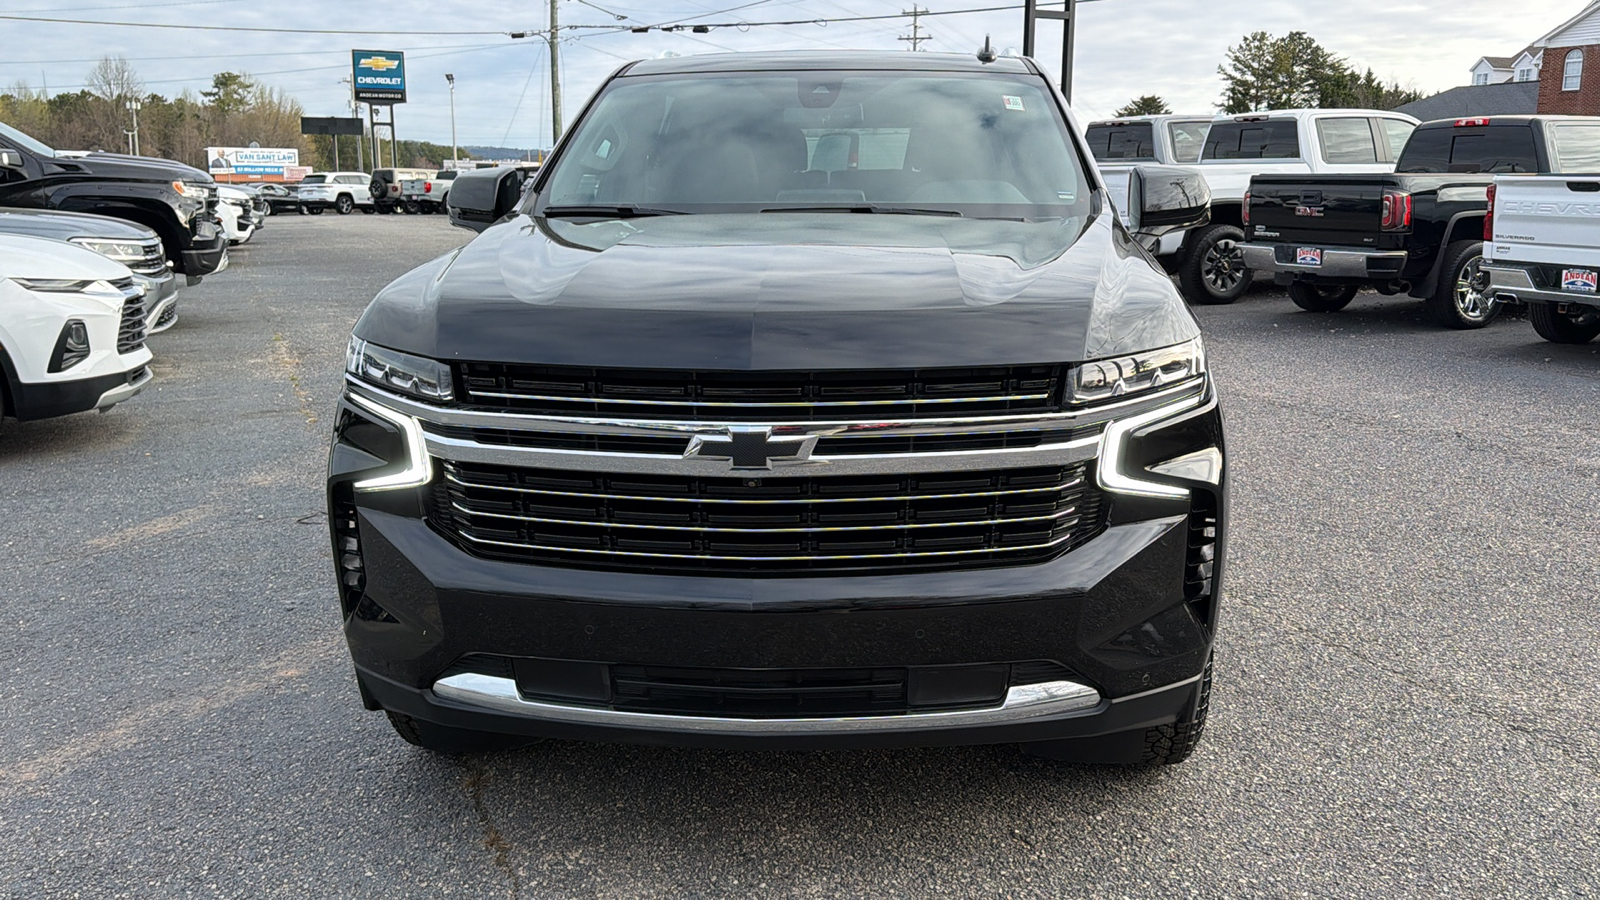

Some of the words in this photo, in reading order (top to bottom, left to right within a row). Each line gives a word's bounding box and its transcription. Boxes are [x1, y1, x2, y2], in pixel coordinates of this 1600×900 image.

[357, 76, 401, 85] CHEVROLET
[256, 153, 275, 161] SANT
[1295, 206, 1324, 216] GMC
[1564, 272, 1597, 285] ANDEAN
